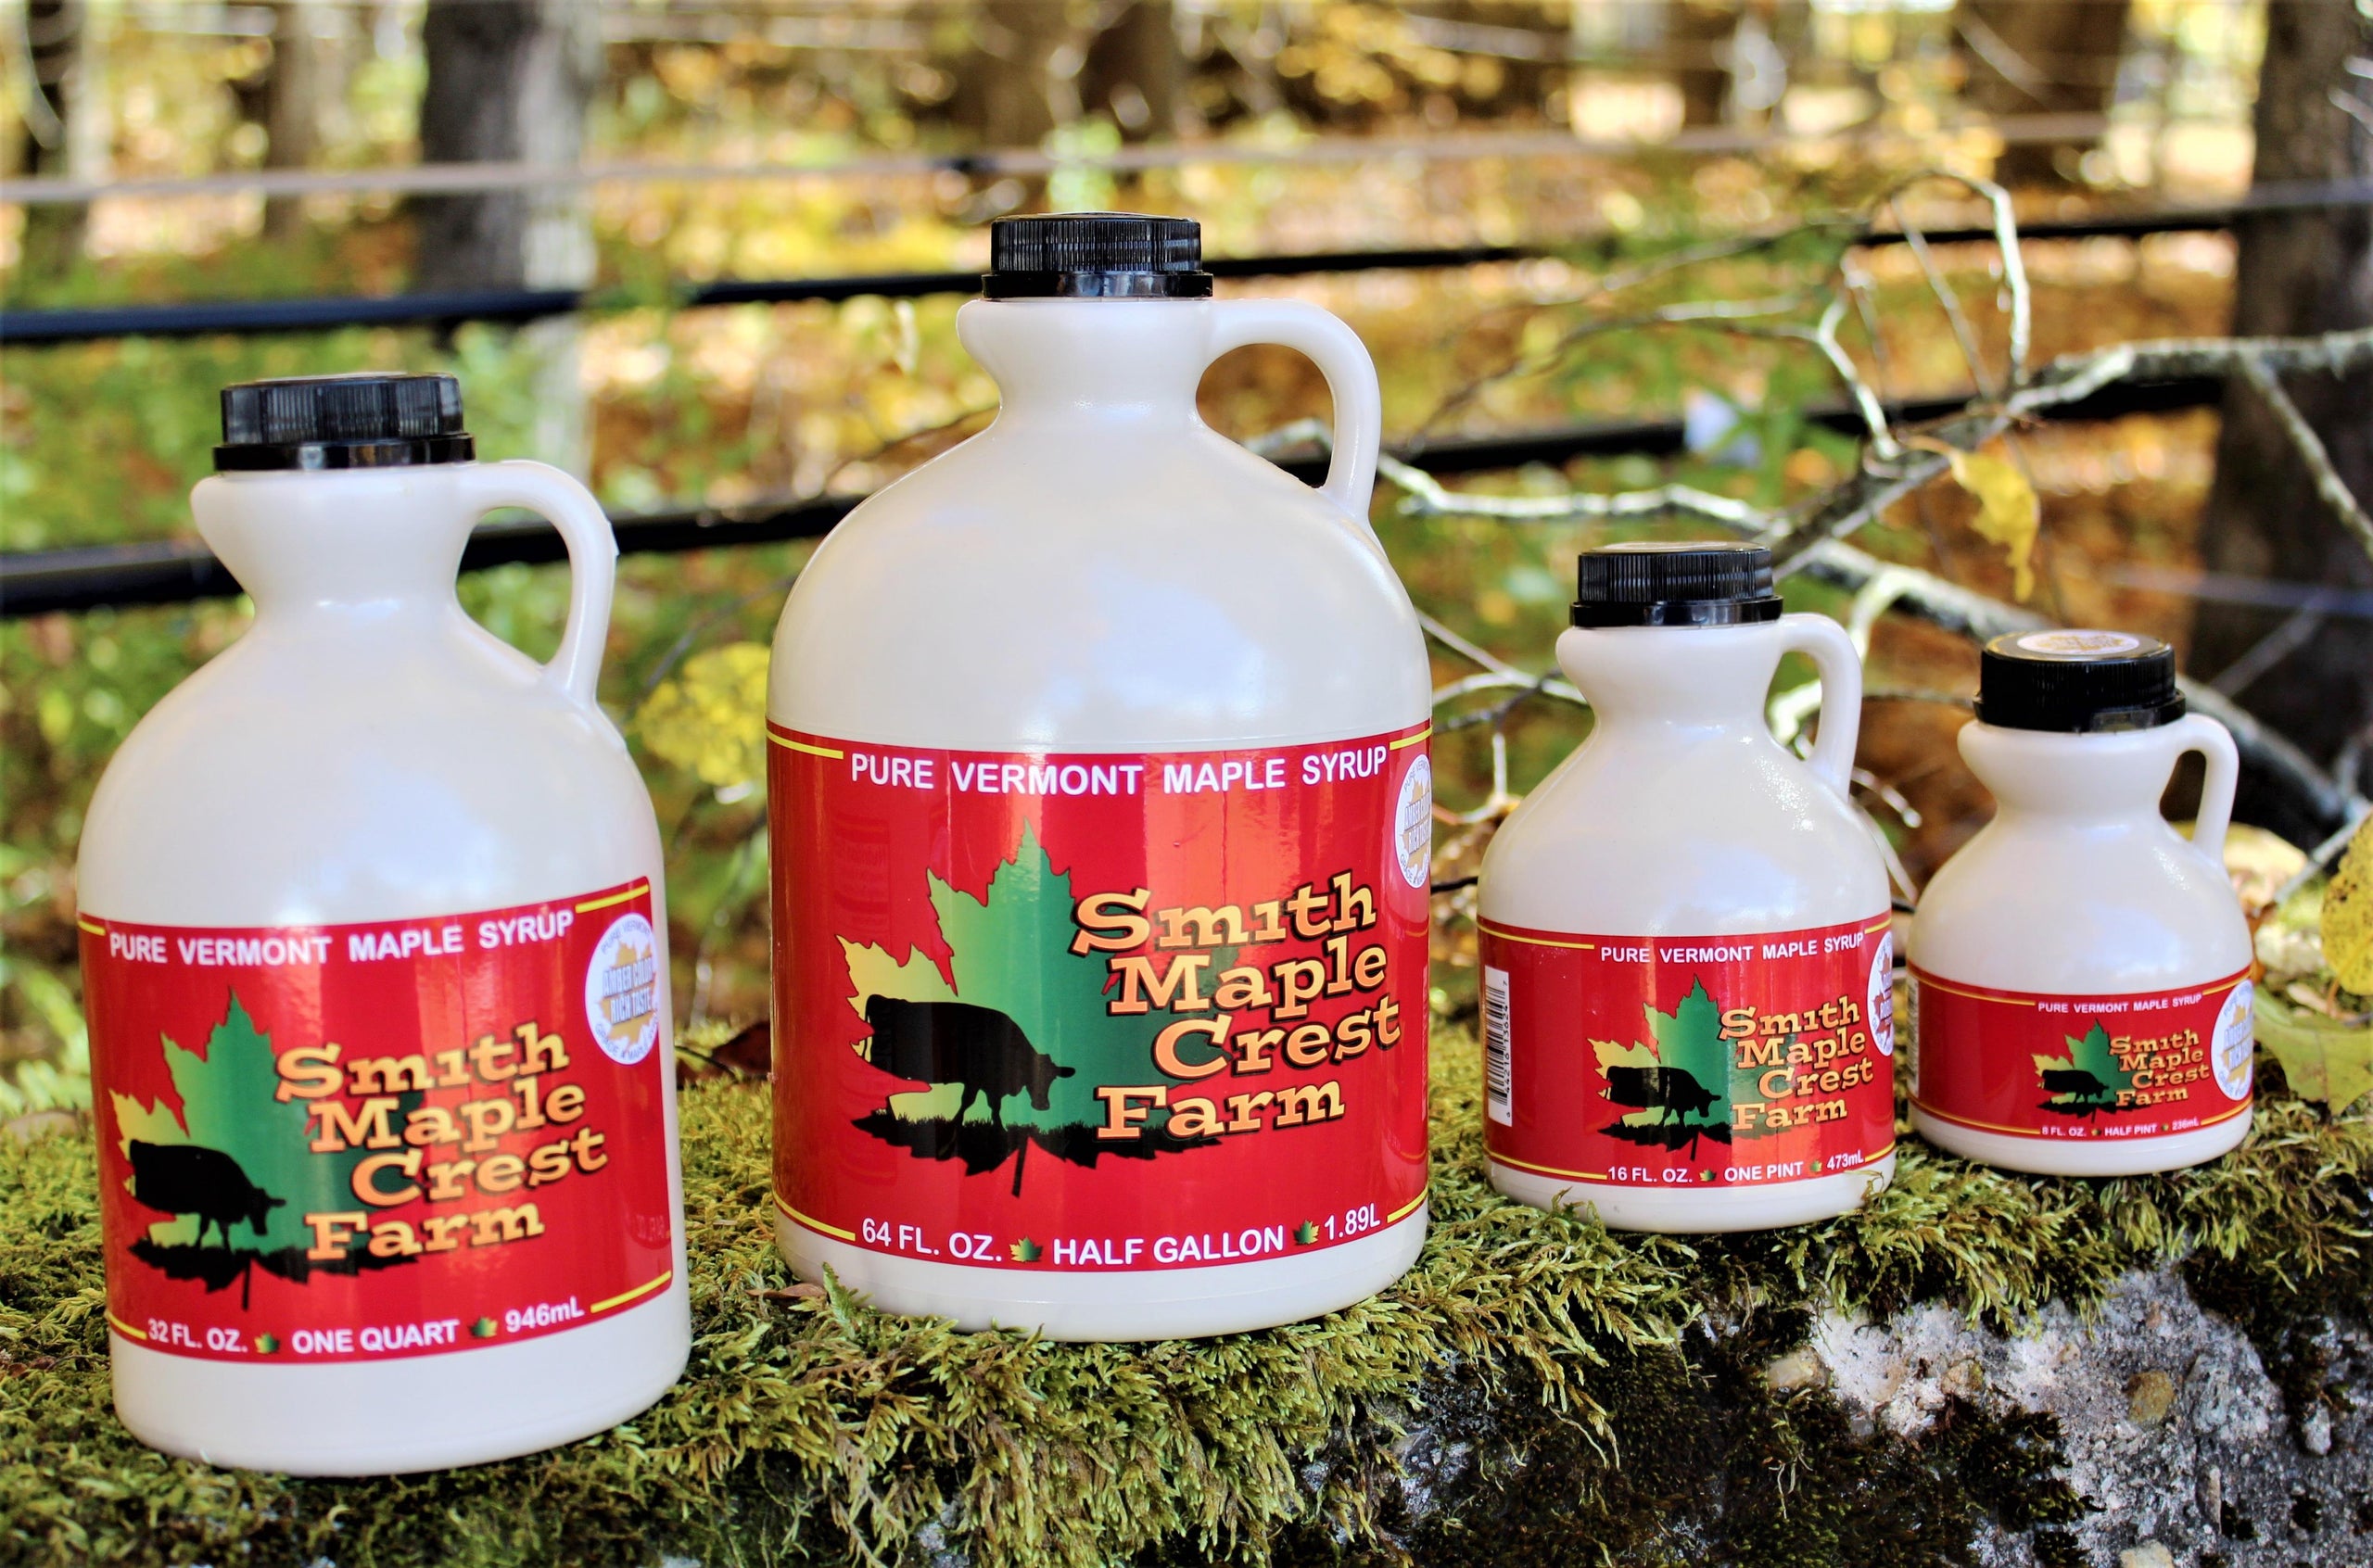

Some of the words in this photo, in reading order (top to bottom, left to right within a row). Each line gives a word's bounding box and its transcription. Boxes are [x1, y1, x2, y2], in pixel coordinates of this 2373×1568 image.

[850, 752, 934, 790] PURE
[951, 763, 1144, 794] VERMONT
[1162, 759, 1286, 794] MAPLE
[1301, 747, 1388, 785] SYRUP
[1072, 871, 1377, 956] Smith
[109, 932, 167, 964] PURE
[177, 936, 332, 966] VERMONT
[349, 928, 463, 963] MAPLE
[478, 909, 574, 949] SYRUP
[1601, 947, 1650, 964] PURE
[1659, 945, 1755, 965] VERMONT
[1762, 940, 1818, 960] MAPLE
[1823, 931, 1864, 955] SYRUP
[601, 965, 633, 997] AMBER
[1107, 936, 1388, 1018] Maple
[609, 993, 633, 1025] RICH
[632, 986, 653, 1018] TASTE
[1719, 996, 1861, 1042] Smith
[2037, 1002, 2069, 1013] PURE
[2073, 1002, 2128, 1013] VERMONT
[2133, 999, 2168, 1012] MAPLE
[2172, 993, 2202, 1006] SYRUP
[594, 1022, 620, 1056] GRADE
[1153, 995, 1402, 1081] Crest
[1736, 1029, 1866, 1071] Maple
[2109, 1028, 2200, 1056] Smith
[2118, 1047, 2203, 1071] Maple
[276, 1022, 570, 1103] Smith
[1758, 1057, 1874, 1101] Crest
[2131, 1064, 2211, 1090] Crest
[309, 1079, 587, 1155] Maple
[1095, 1078, 1346, 1141] Farm
[1731, 1099, 1848, 1131] Farm
[2115, 1087, 2189, 1106] Farm
[2042, 1127, 2049, 1135] 8
[2050, 1127, 2066, 1136] FL.
[2068, 1128, 2087, 1137] OZ.
[2104, 1126, 2130, 1136] HALF
[2134, 1124, 2157, 1135] PINT
[350, 1127, 609, 1207] Crest
[1607, 1166, 1628, 1182] 16
[1631, 1168, 1657, 1182] FL.
[1662, 1168, 1693, 1183] OZ.
[1724, 1166, 1762, 1182] ONE
[1766, 1161, 1804, 1181] PINT
[1826, 1149, 1864, 1171] 473mL
[304, 1201, 545, 1262] Farm
[861, 1218, 892, 1246] 64
[898, 1225, 940, 1255] FL.
[951, 1231, 1002, 1262] OZ.
[1052, 1237, 1144, 1265] HALF
[1152, 1225, 1284, 1261] GALLON
[1324, 1204, 1381, 1242] 1.89L
[147, 1319, 168, 1344] 32
[172, 1323, 203, 1349] FL.
[207, 1329, 248, 1354] OZ.
[291, 1329, 355, 1355] ONE
[360, 1319, 459, 1352] QUART
[505, 1296, 586, 1334] 946mL
